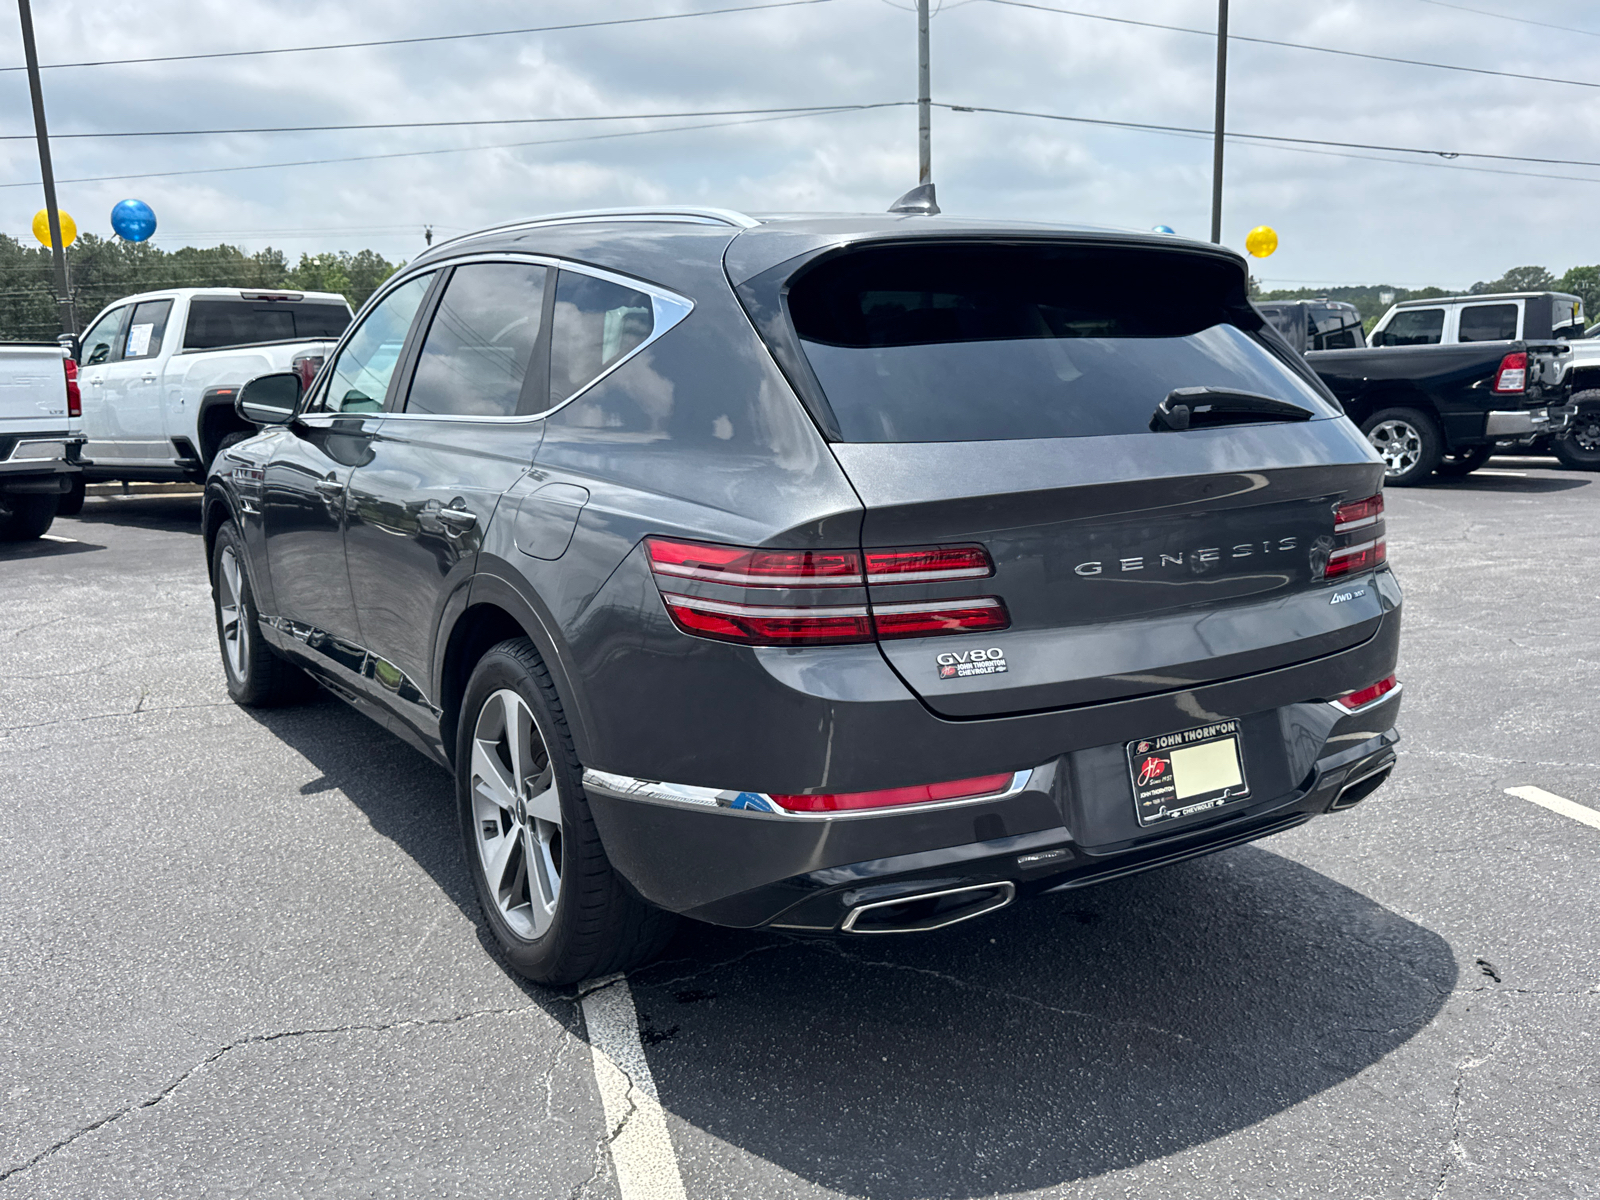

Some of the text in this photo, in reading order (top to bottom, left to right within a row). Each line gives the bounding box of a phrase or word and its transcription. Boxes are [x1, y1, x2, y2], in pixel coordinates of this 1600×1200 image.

[1074, 537, 1298, 576] GENESIS
[937, 647, 1004, 665] GV80
[957, 659, 1006, 671] JOHN THORNTON
[957, 667, 995, 676] CHEVROLET
[1156, 733, 1182, 749] JOHN
[1182, 801, 1215, 815] CHEVROLET
